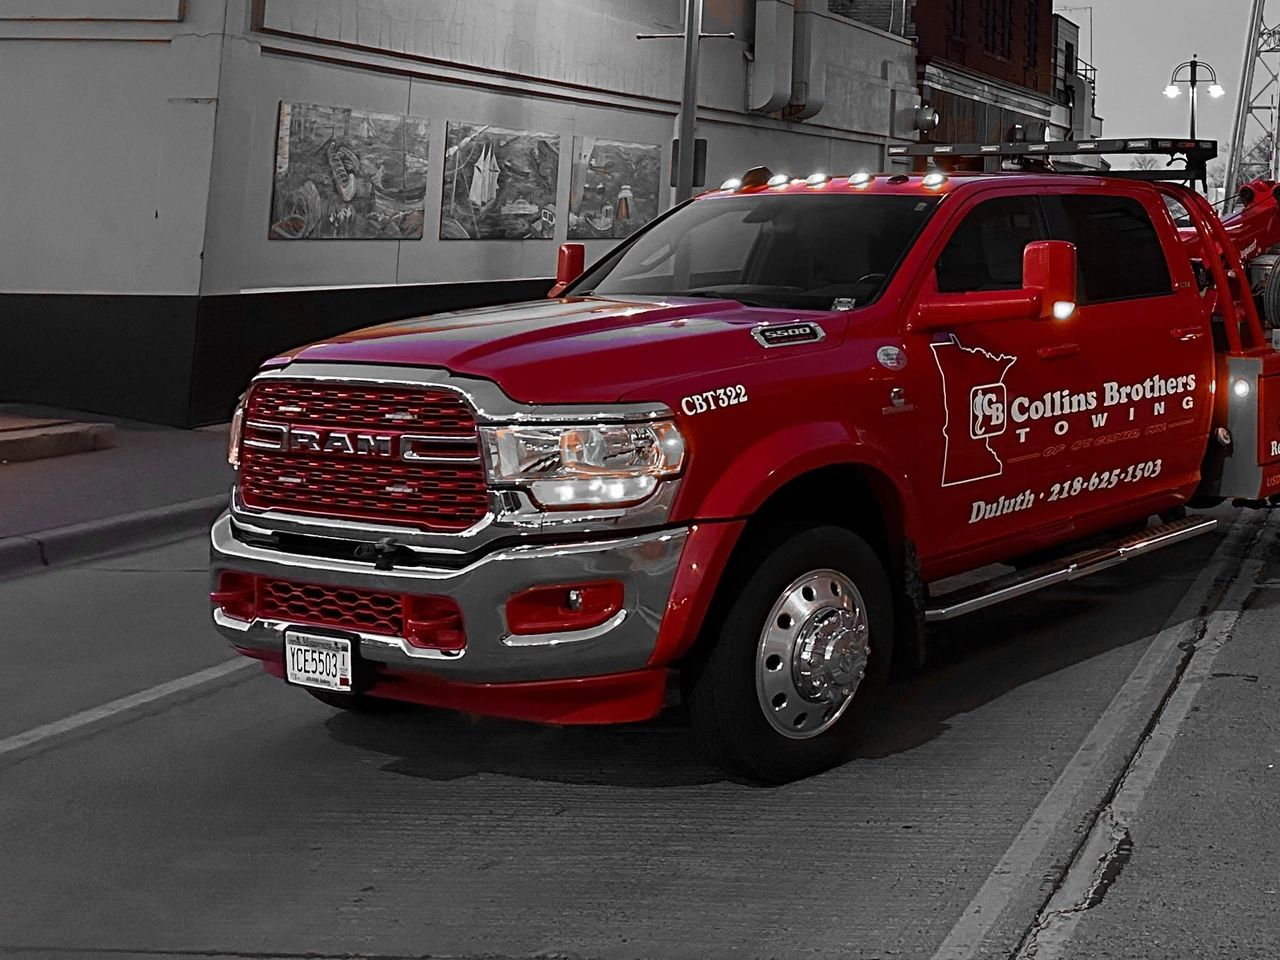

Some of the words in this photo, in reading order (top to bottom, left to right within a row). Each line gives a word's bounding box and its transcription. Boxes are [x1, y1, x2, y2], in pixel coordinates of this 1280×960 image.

[764, 327, 811, 339] 5500
[681, 384, 748, 416] CBT322
[1011, 389, 1097, 422] Collins
[1103, 373, 1196, 407] Brothers
[1016, 396, 1194, 443] TOWING
[291, 429, 392, 456] RAM
[968, 489, 1035, 524] Duluth
[290, 646, 338, 678] YCE5503
